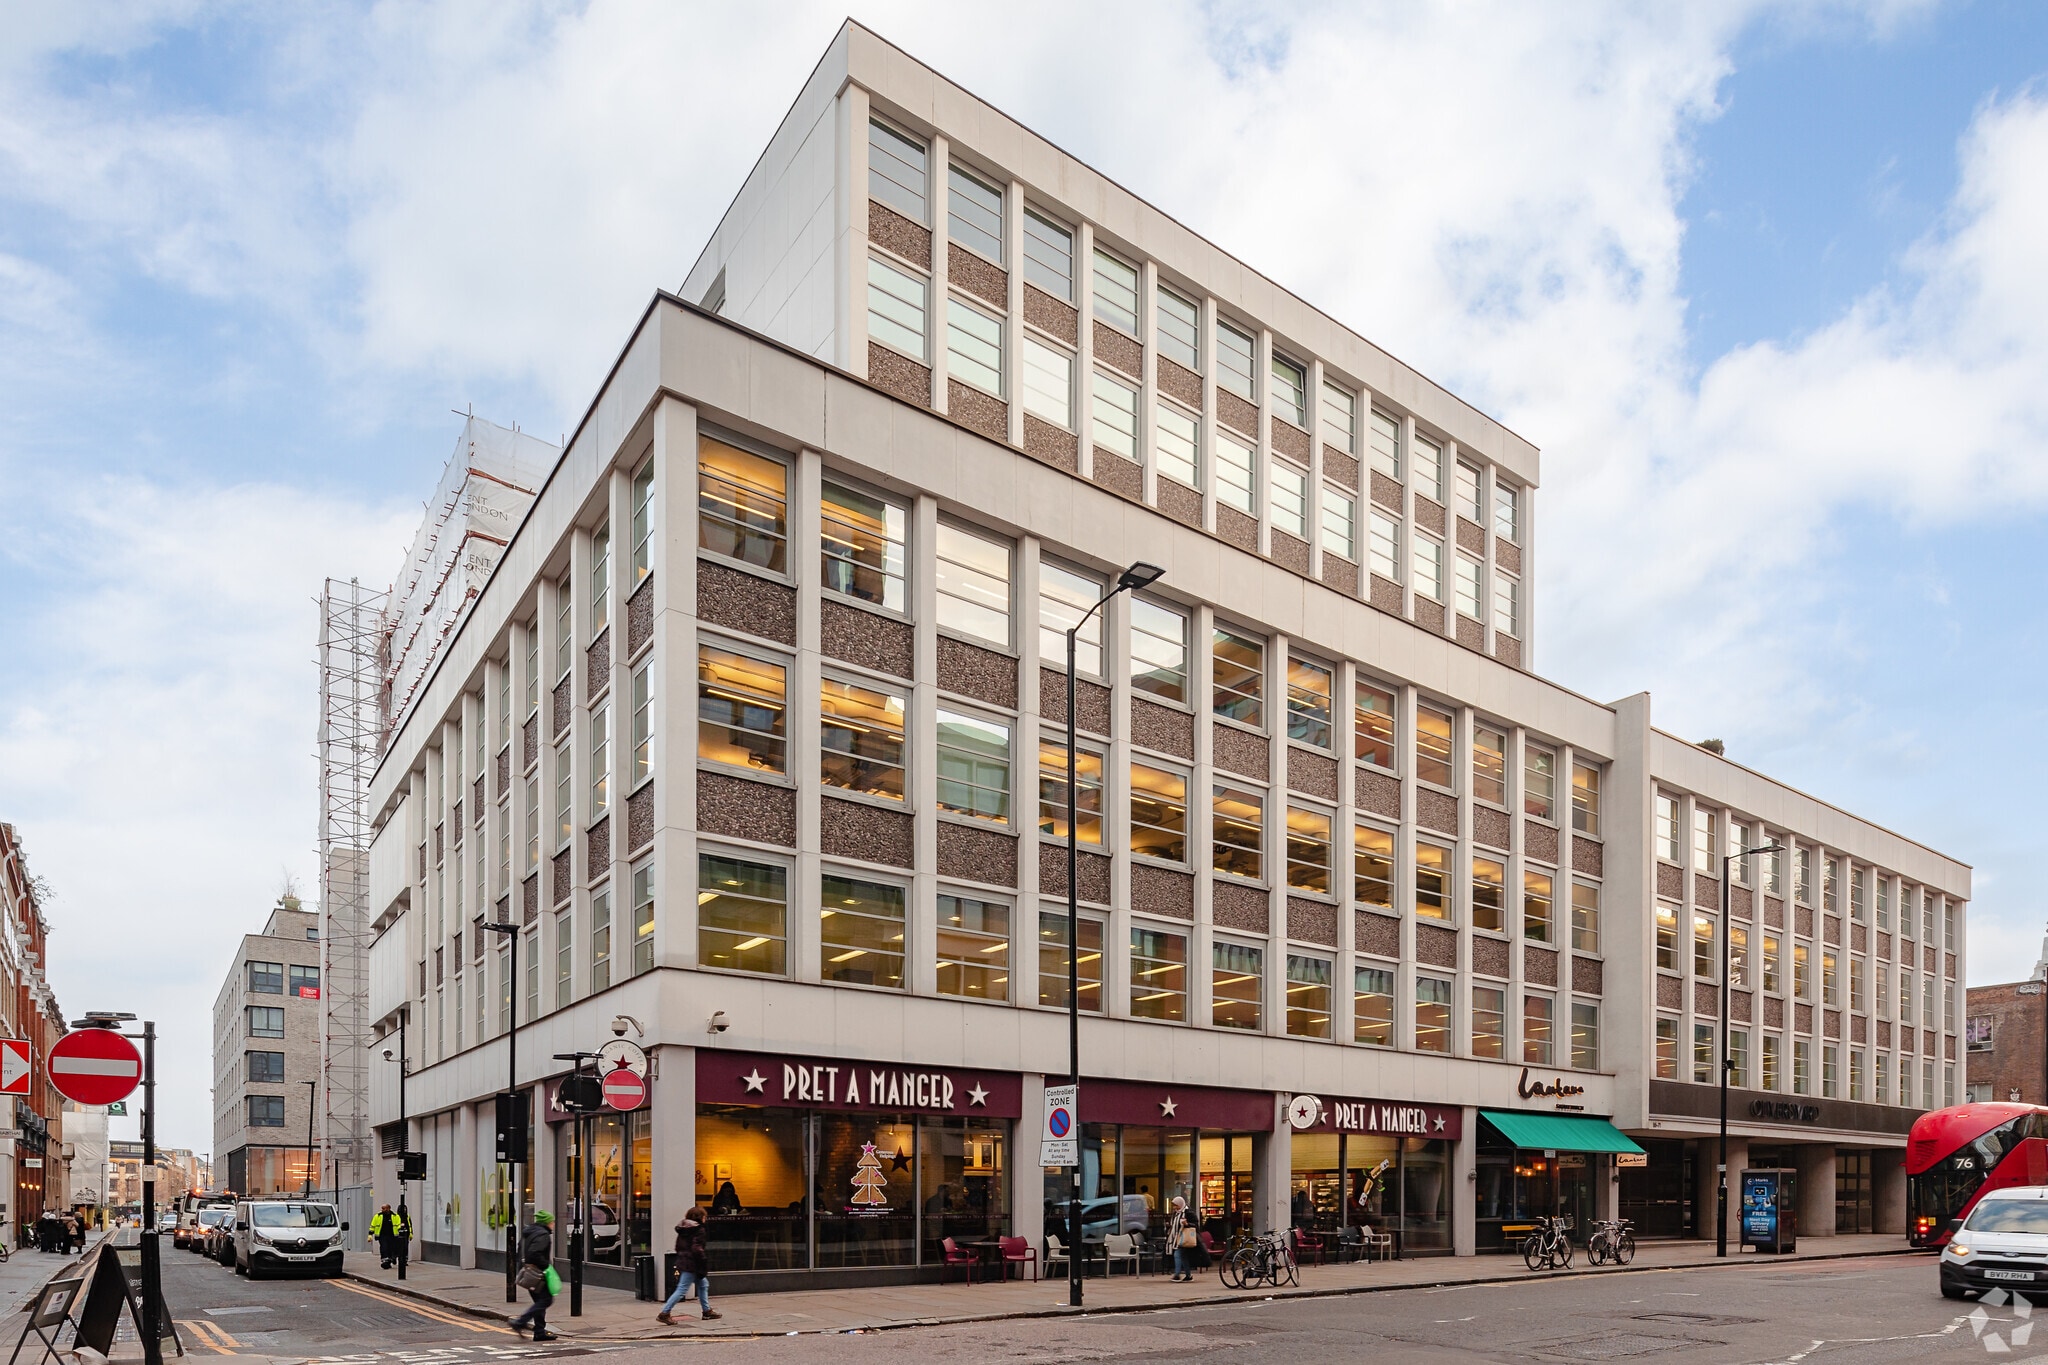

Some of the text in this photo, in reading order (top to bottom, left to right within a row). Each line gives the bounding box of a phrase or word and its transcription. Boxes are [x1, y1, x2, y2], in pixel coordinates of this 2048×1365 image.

[783, 1063, 954, 1109] PRET A MANGER
[1046, 1087, 1075, 1097] Controlled
[1050, 1097, 1070, 1106] ZONE
[1335, 1102, 1365, 1130] PRET
[1368, 1105, 1378, 1131] A
[1381, 1106, 1427, 1133] MANGER
[1955, 1157, 1974, 1169] 76
